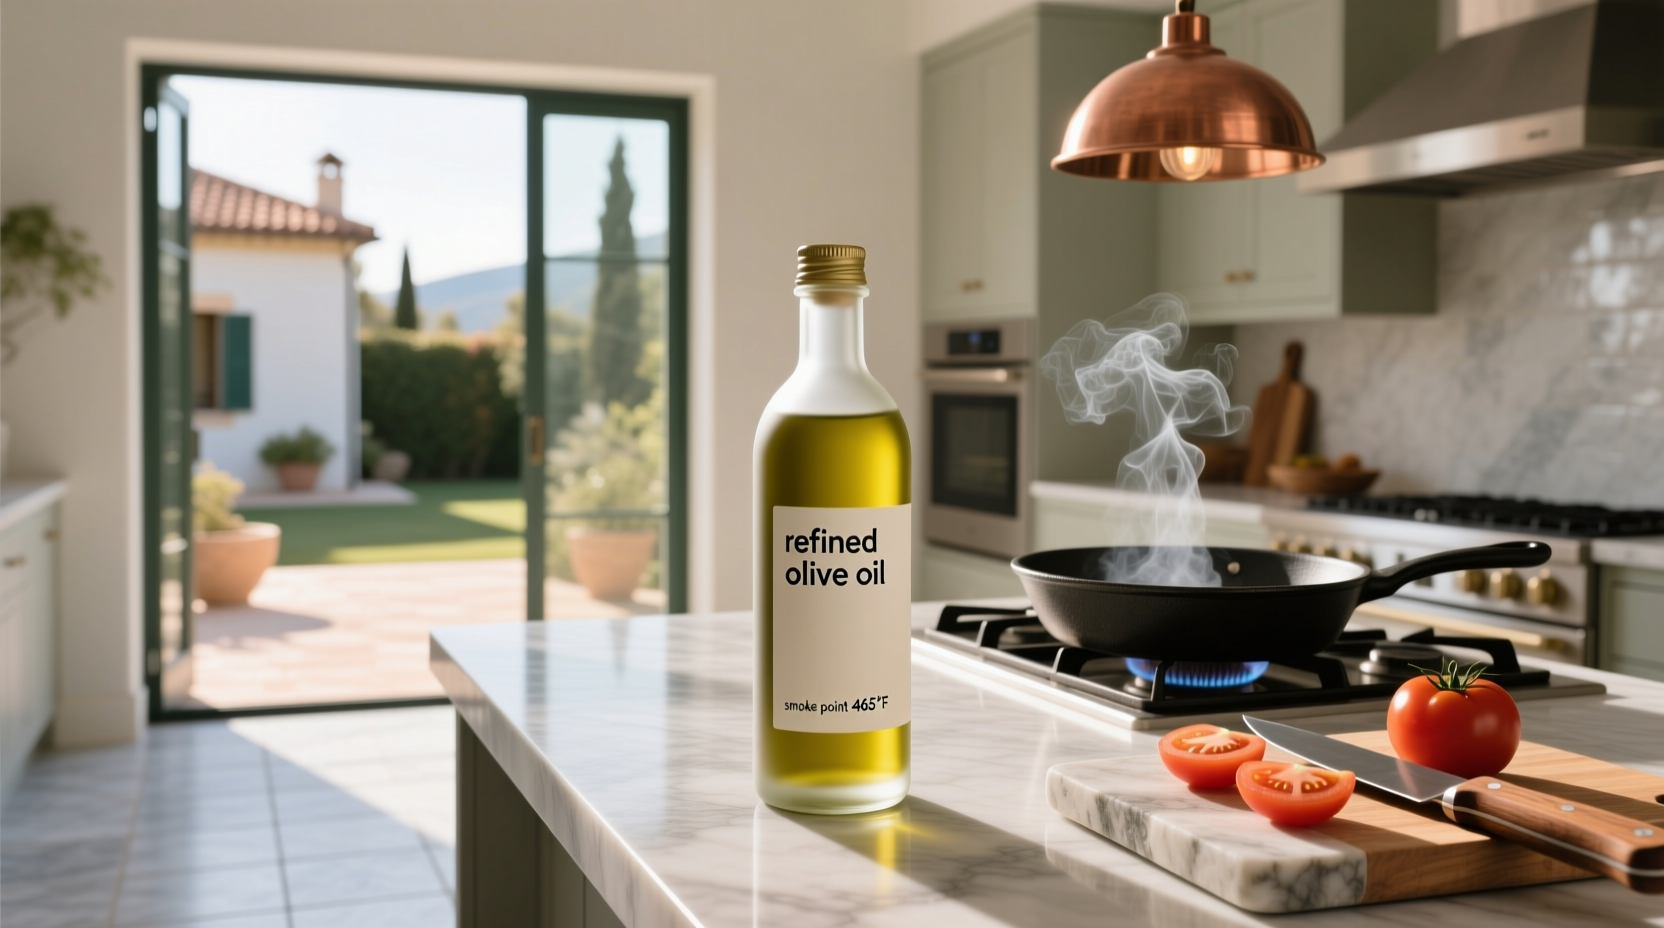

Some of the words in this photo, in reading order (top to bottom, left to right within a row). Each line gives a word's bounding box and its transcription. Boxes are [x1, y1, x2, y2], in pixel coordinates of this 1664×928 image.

[785, 528, 877, 554] refined
[785, 560, 849, 586] olive
[855, 560, 886, 586] oil
[784, 699, 817, 712] smoke
[820, 700, 848, 715] point
